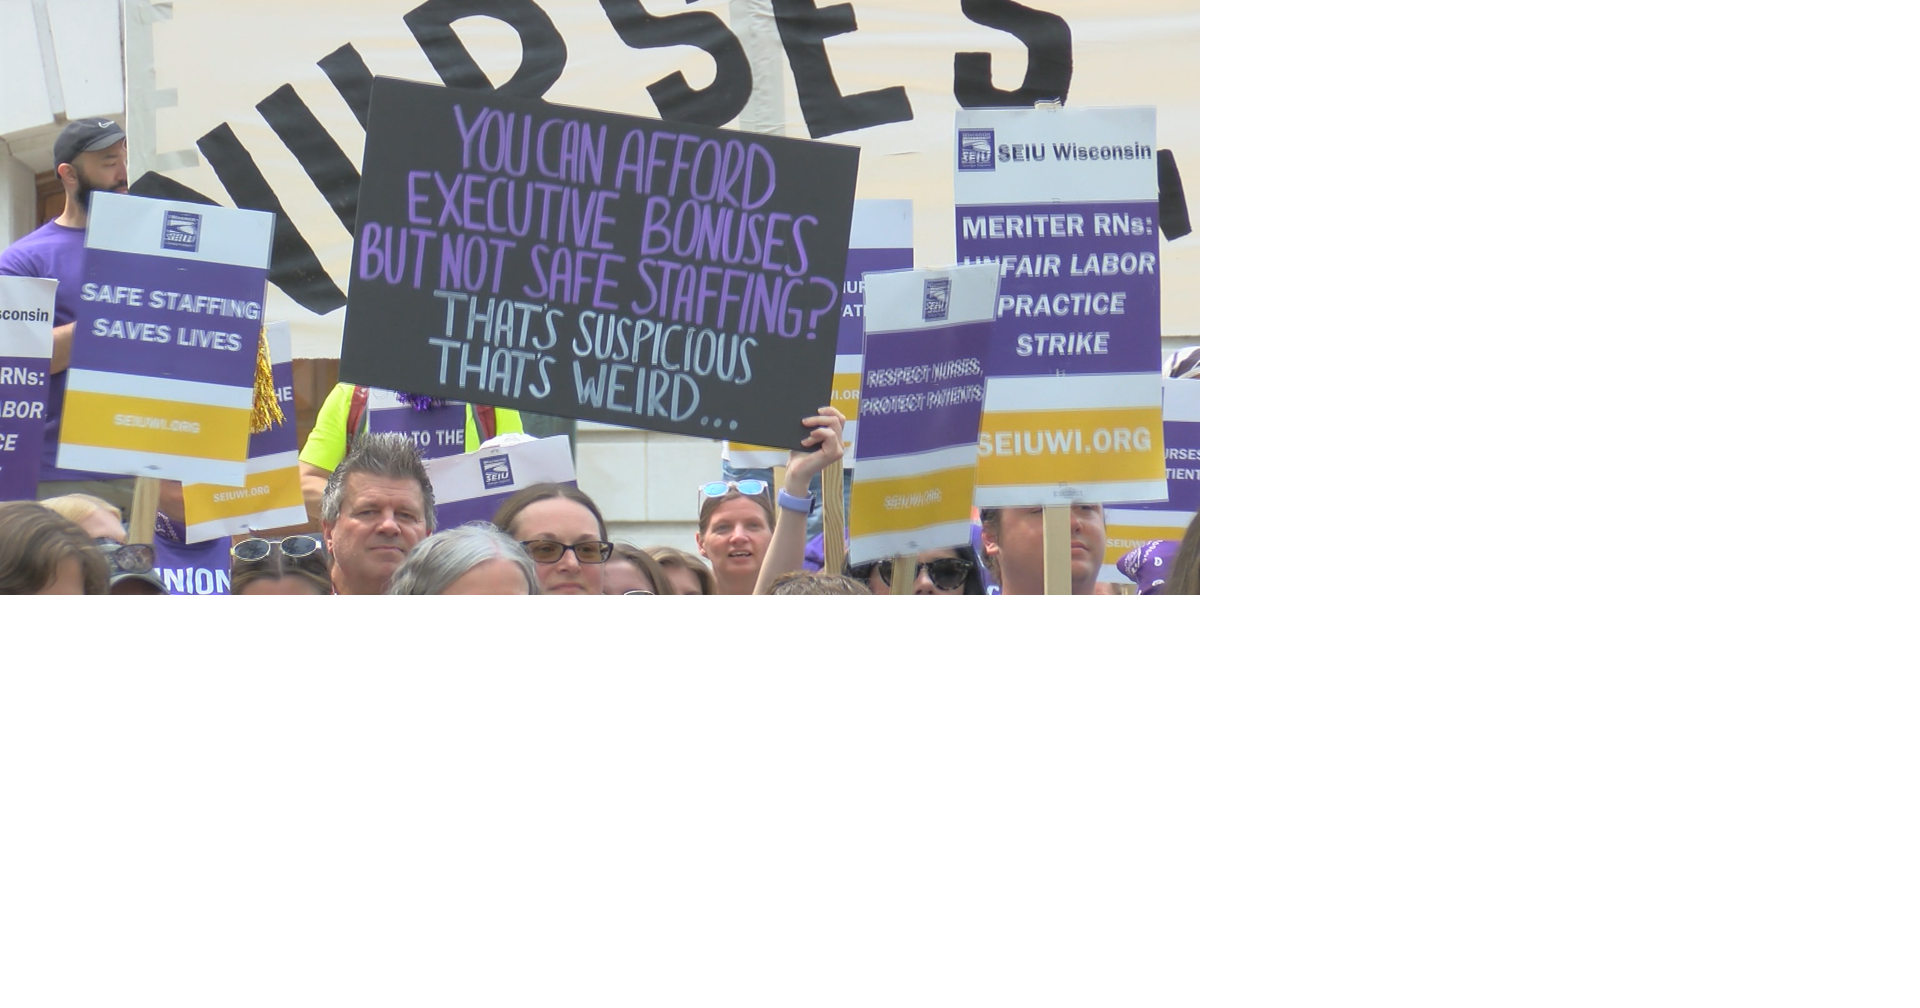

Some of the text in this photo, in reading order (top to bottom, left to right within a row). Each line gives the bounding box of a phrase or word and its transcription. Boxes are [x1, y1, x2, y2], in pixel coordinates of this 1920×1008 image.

[453, 104, 776, 210] YOU CAN AFFORD
[997, 141, 1153, 162] SEIU Wisconsin
[408, 170, 819, 277] EXECUTIVE BONUSES
[962, 212, 1153, 240] MERITER RNs:
[1070, 252, 1156, 277] LABOR
[359, 222, 838, 340] BUT NOT SAFE STAFFING?
[80, 282, 262, 320] SAFE STAFFING
[997, 291, 1127, 318] PRACTICE
[0, 308, 49, 322] consin
[91, 318, 243, 352] SAVES LIVES
[433, 289, 759, 386] THAT'S SUSPICIOUS
[1015, 331, 1110, 357] STRIKE
[428, 336, 739, 431] THAT'S WEIRD...
[867, 364, 931, 388] RESPECT
[0, 400, 44, 419] BOR
[860, 392, 925, 416] PROTECT
[113, 413, 201, 434] SEIUWI.ORG
[435, 428, 465, 446] THE
[976, 426, 1152, 457] SEIUWI.ORG
[213, 485, 270, 503] SEIUWI.ORG
